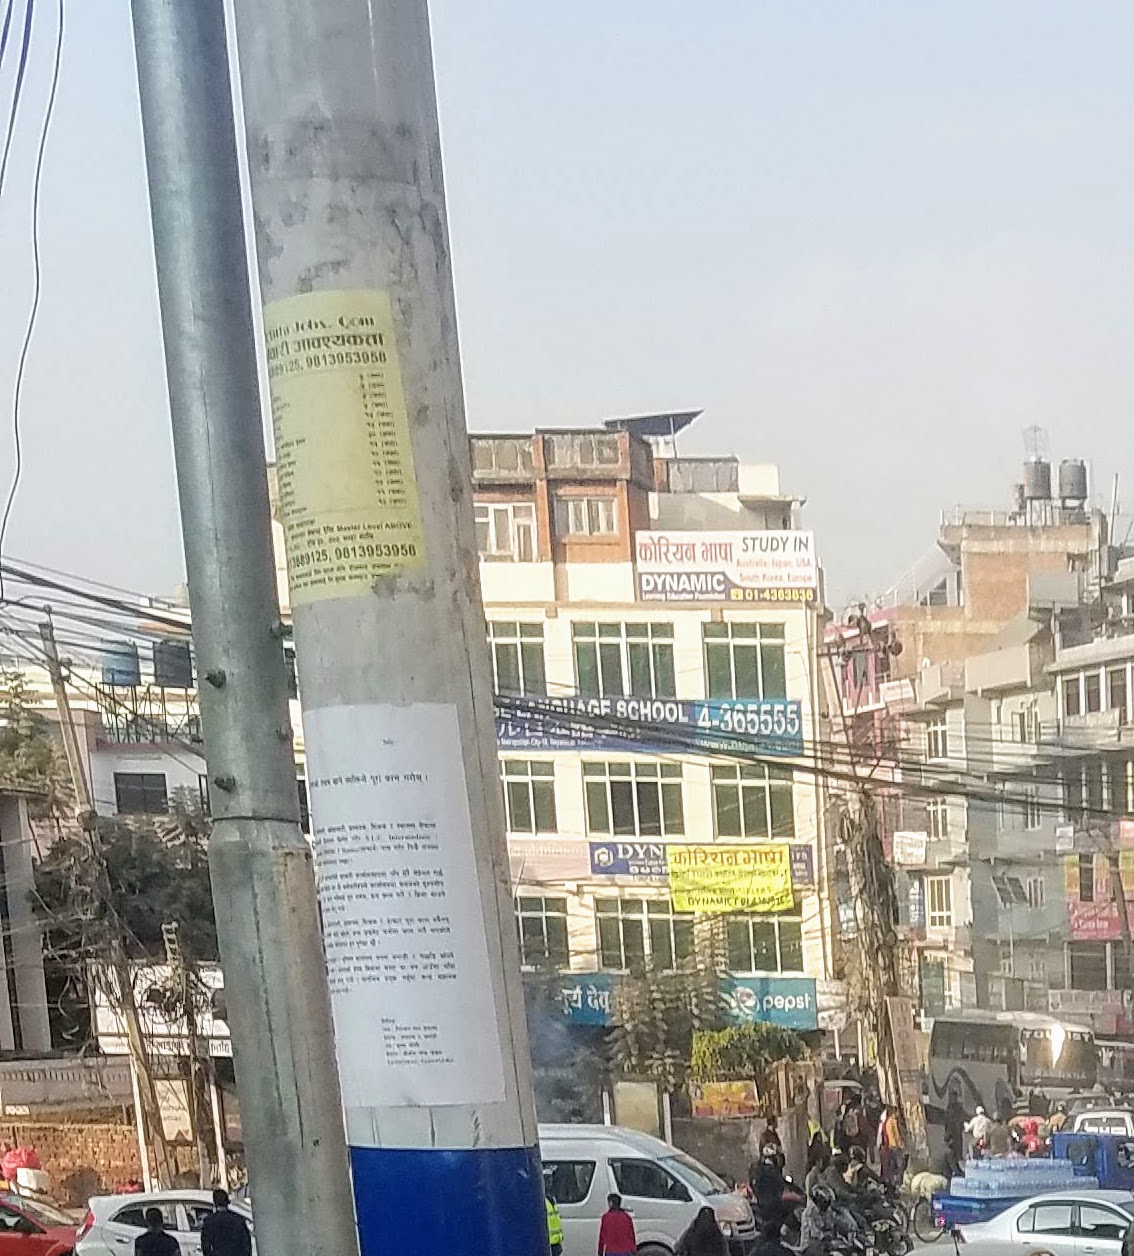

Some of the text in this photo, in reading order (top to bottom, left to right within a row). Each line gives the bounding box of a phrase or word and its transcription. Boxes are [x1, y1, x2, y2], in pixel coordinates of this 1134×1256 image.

[639, 535, 733, 564] कोरियन भाषा
[742, 536, 809, 552] STUDY IN
[641, 574, 726, 591] DYNAMIC
[616, 699, 689, 723] SCHOOL
[673, 846, 738, 866] कोरियन
[742, 849, 783, 866] भाषा
[1022, 1029, 1092, 1043] TOUIST
